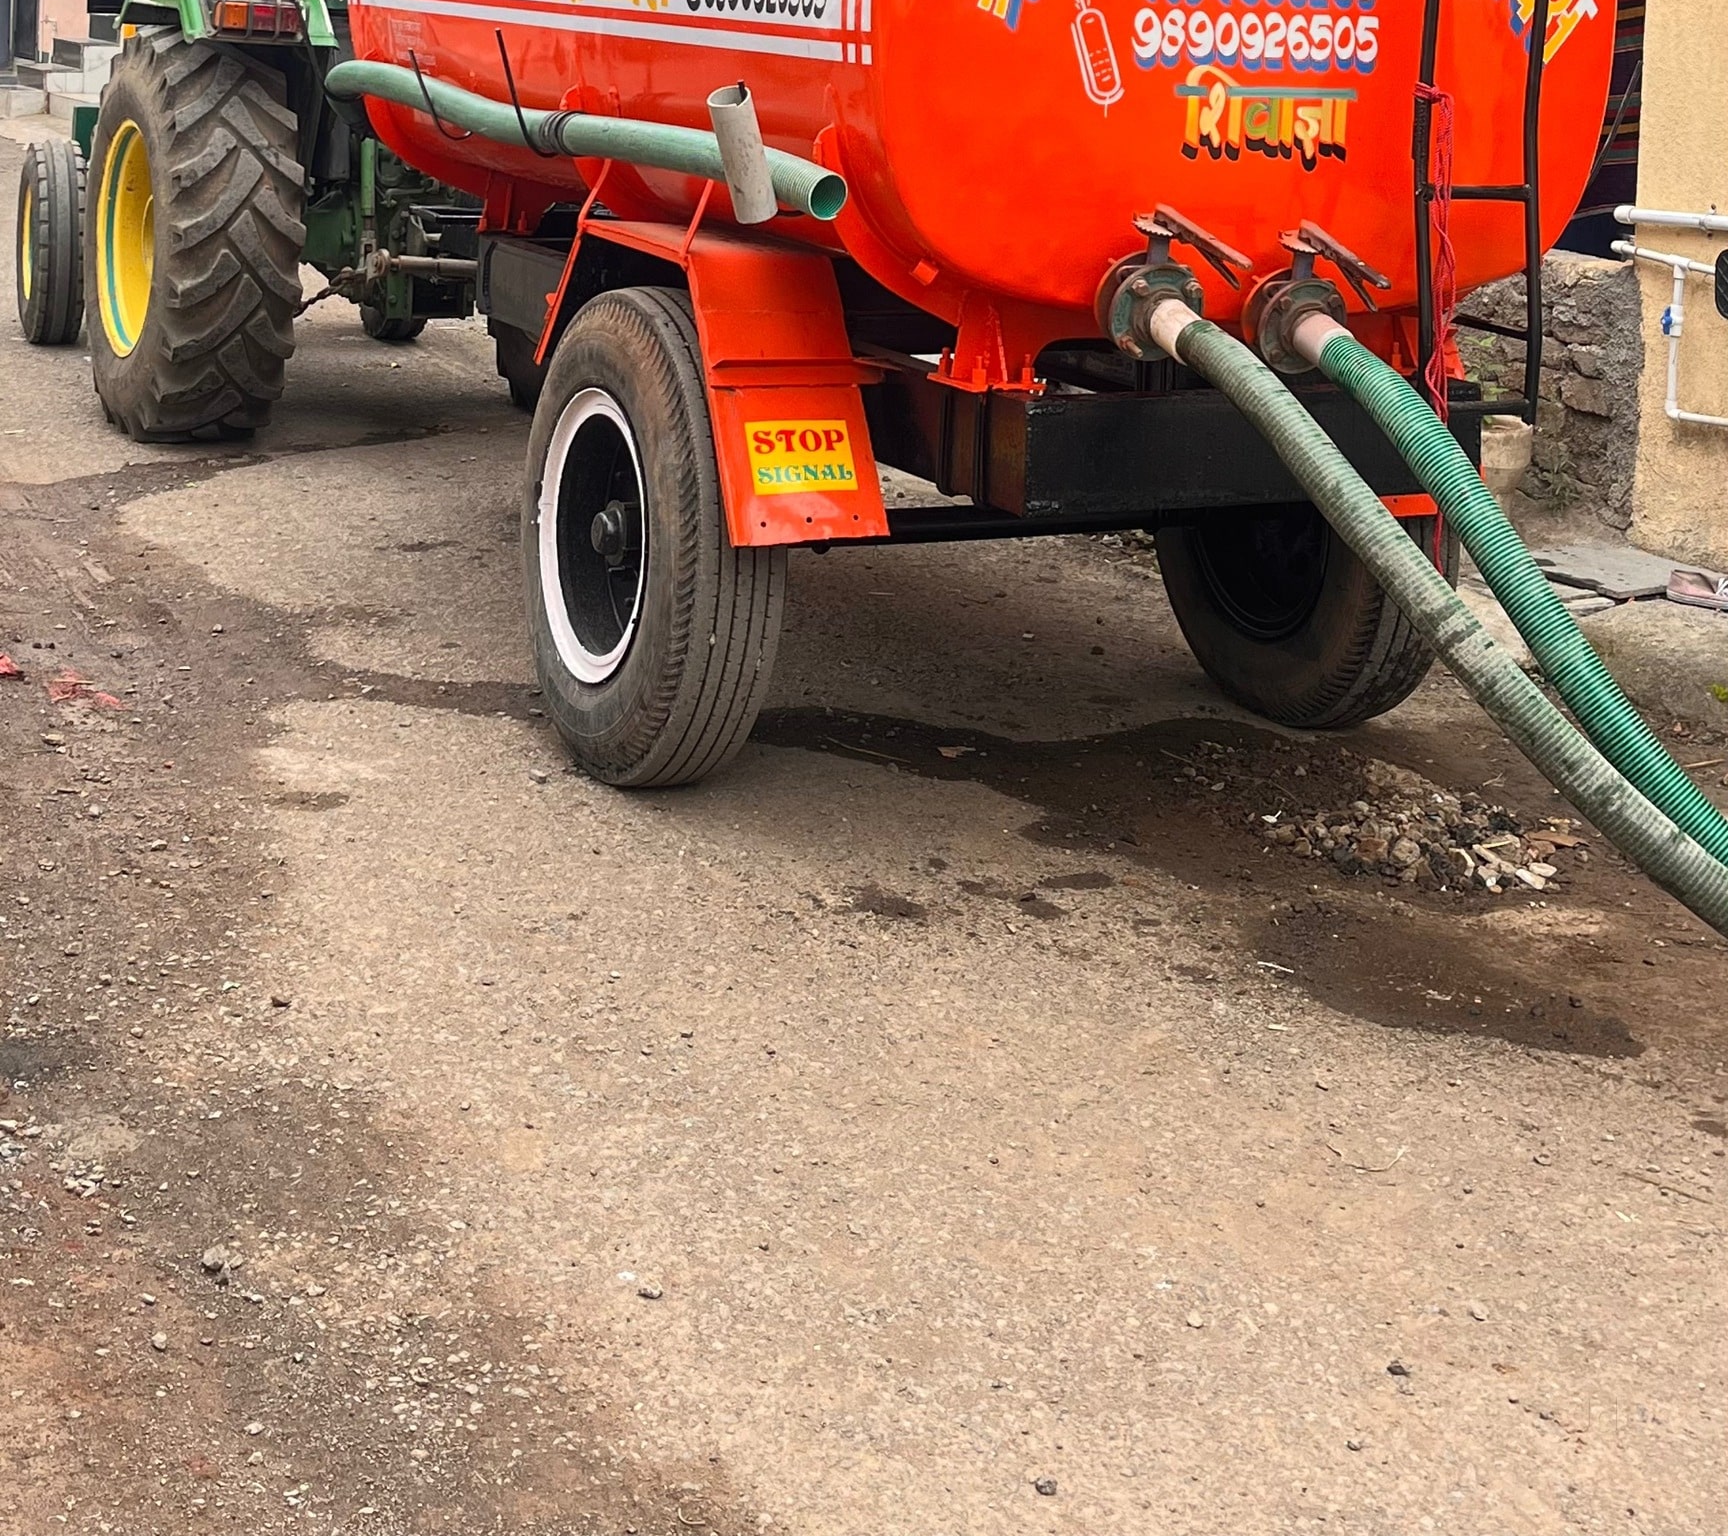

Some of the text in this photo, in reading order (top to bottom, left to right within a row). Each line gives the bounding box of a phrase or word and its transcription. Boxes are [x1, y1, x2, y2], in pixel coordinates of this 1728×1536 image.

[1131, 7, 1380, 73] 9890926505
[753, 429, 844, 454] STOP
[757, 464, 853, 485] SIGNAL
